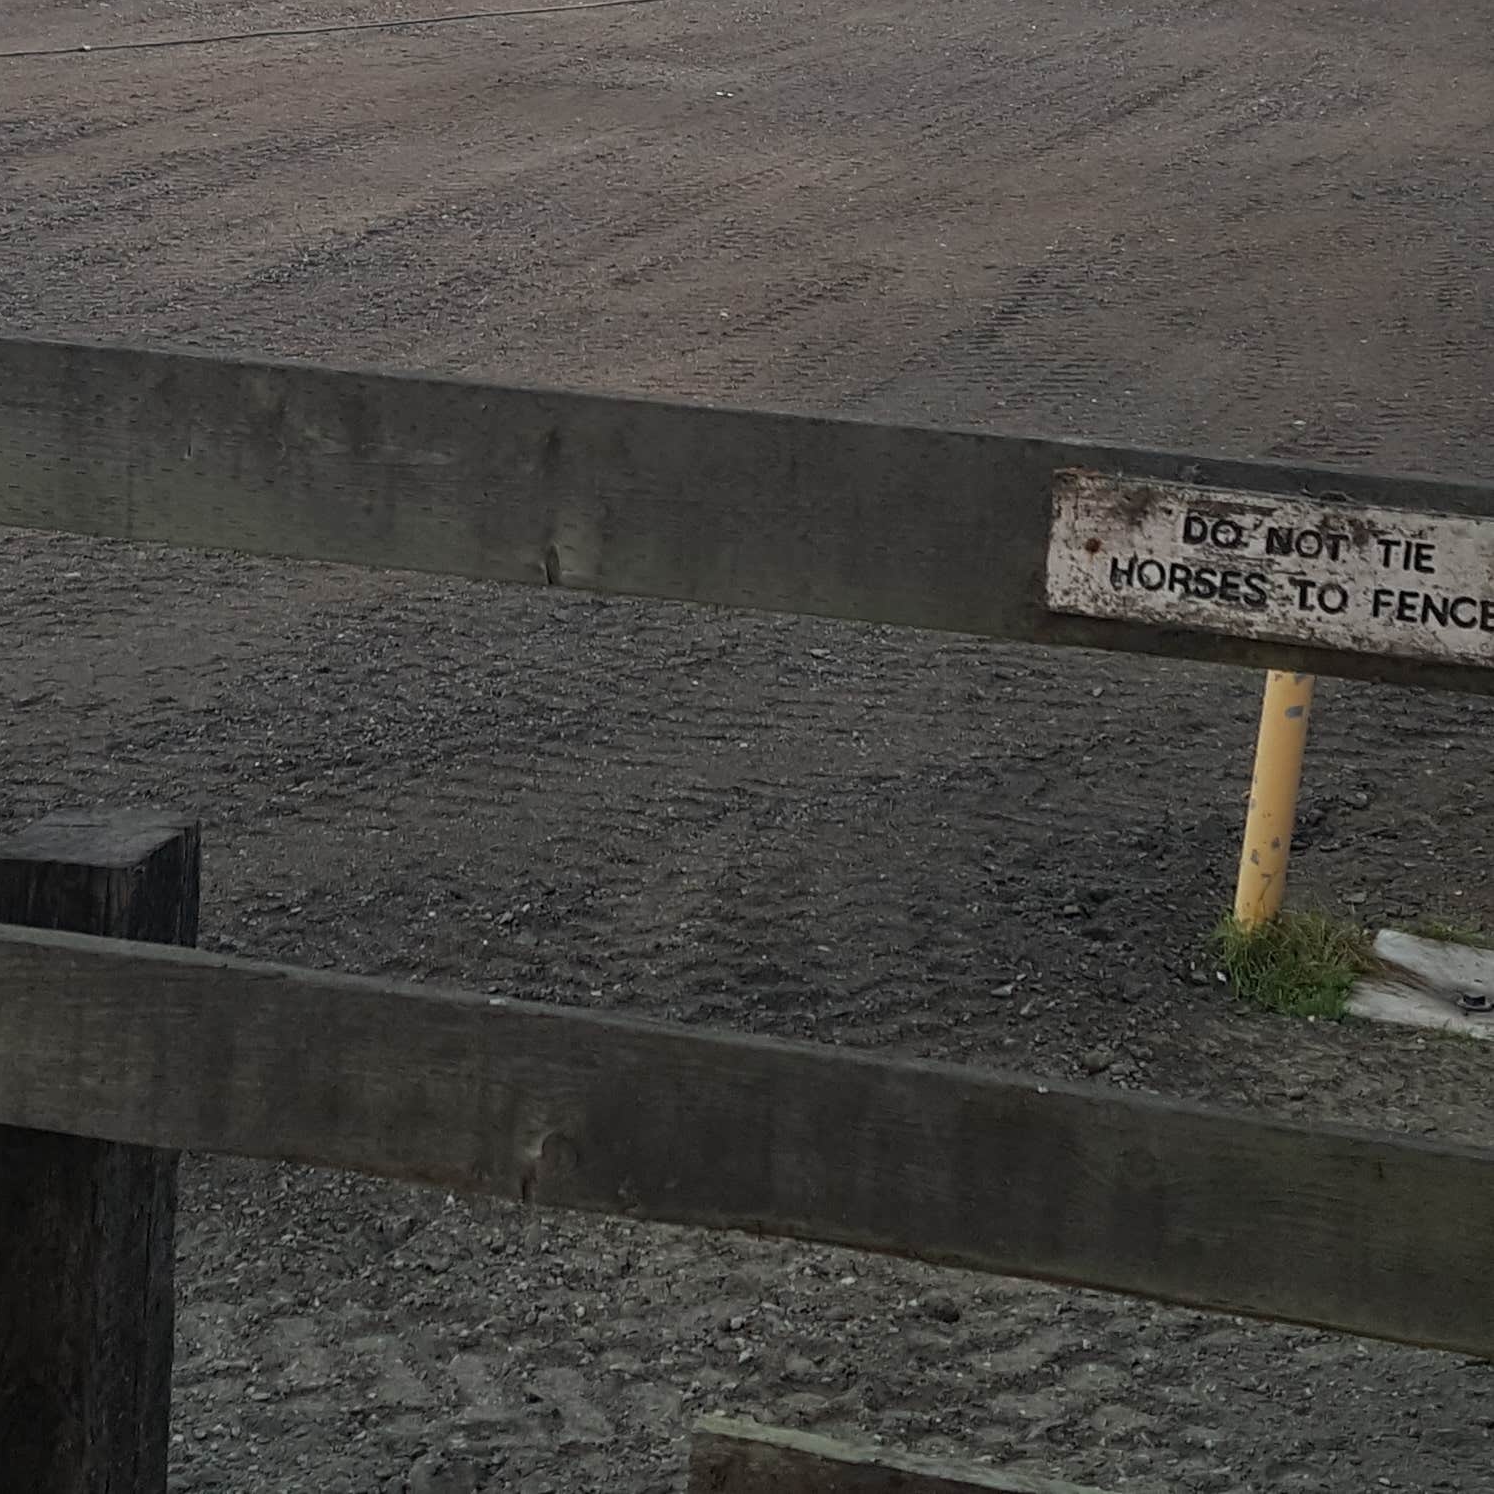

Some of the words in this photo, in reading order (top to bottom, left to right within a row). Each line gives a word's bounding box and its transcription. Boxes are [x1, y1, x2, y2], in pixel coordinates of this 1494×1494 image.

[1183, 515, 1244, 549] DO
[1265, 526, 1351, 562] NOT
[1377, 538, 1436, 575] TIE
[1110, 555, 1268, 608] HORSES
[1288, 576, 1349, 615] TO
